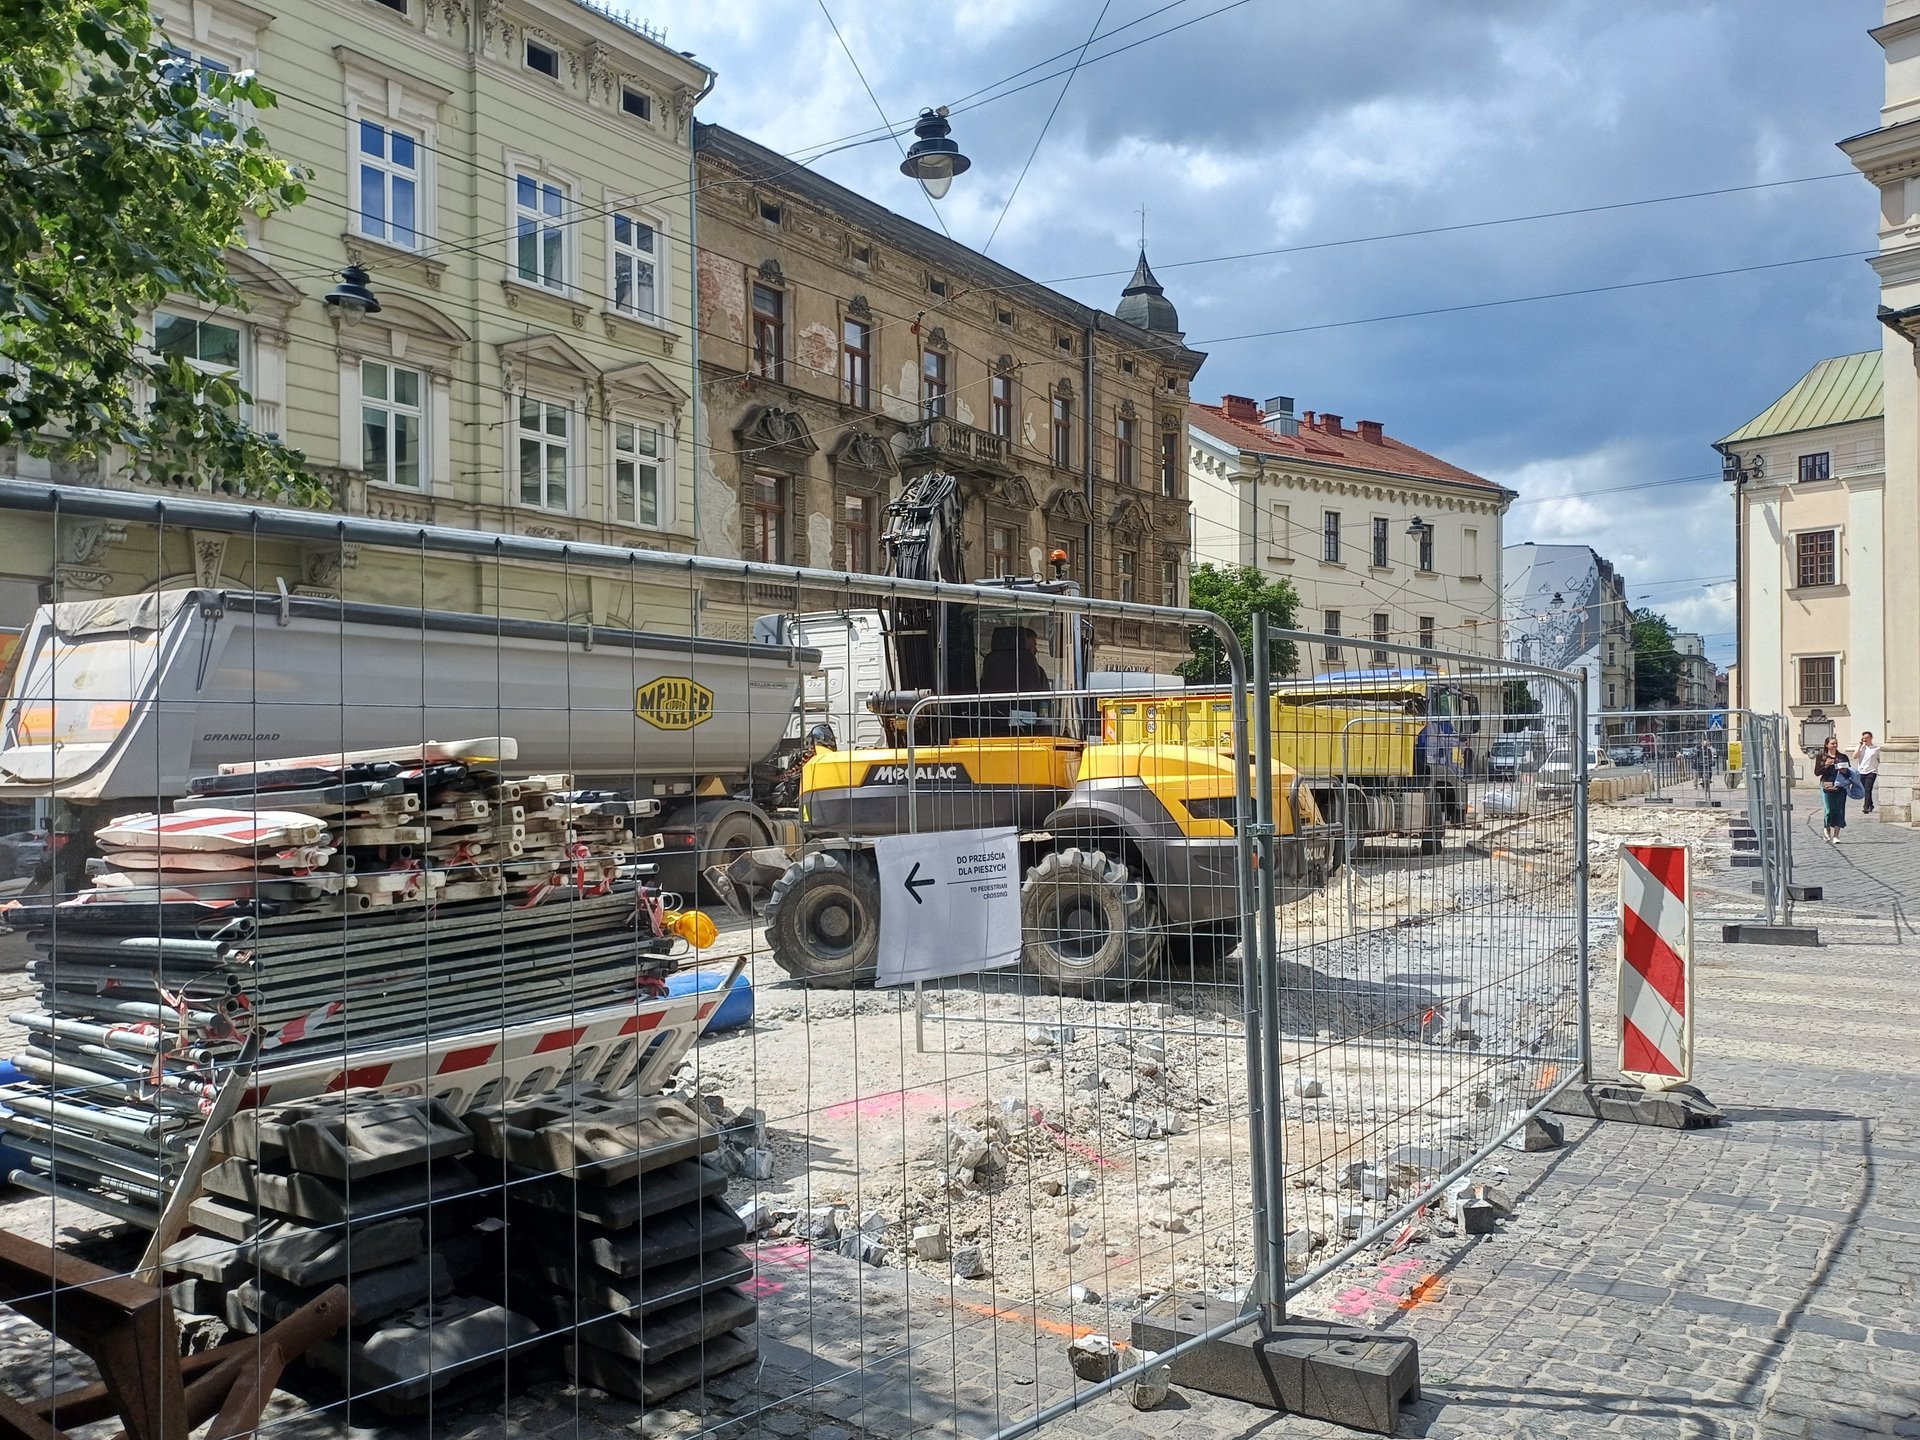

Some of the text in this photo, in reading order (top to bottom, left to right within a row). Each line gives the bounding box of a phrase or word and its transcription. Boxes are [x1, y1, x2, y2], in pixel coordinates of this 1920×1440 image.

[640, 682, 710, 724] MEILLER
[665, 700, 686, 711] KIPPER
[203, 733, 281, 741] GRANDLOAD
[956, 851, 1006, 865] DO PRZEJŚCIA
[958, 863, 1007, 876] DLA PIESZYCH
[977, 883, 1008, 893] PEDESTRIAN
[983, 891, 1008, 900] CROSSING
